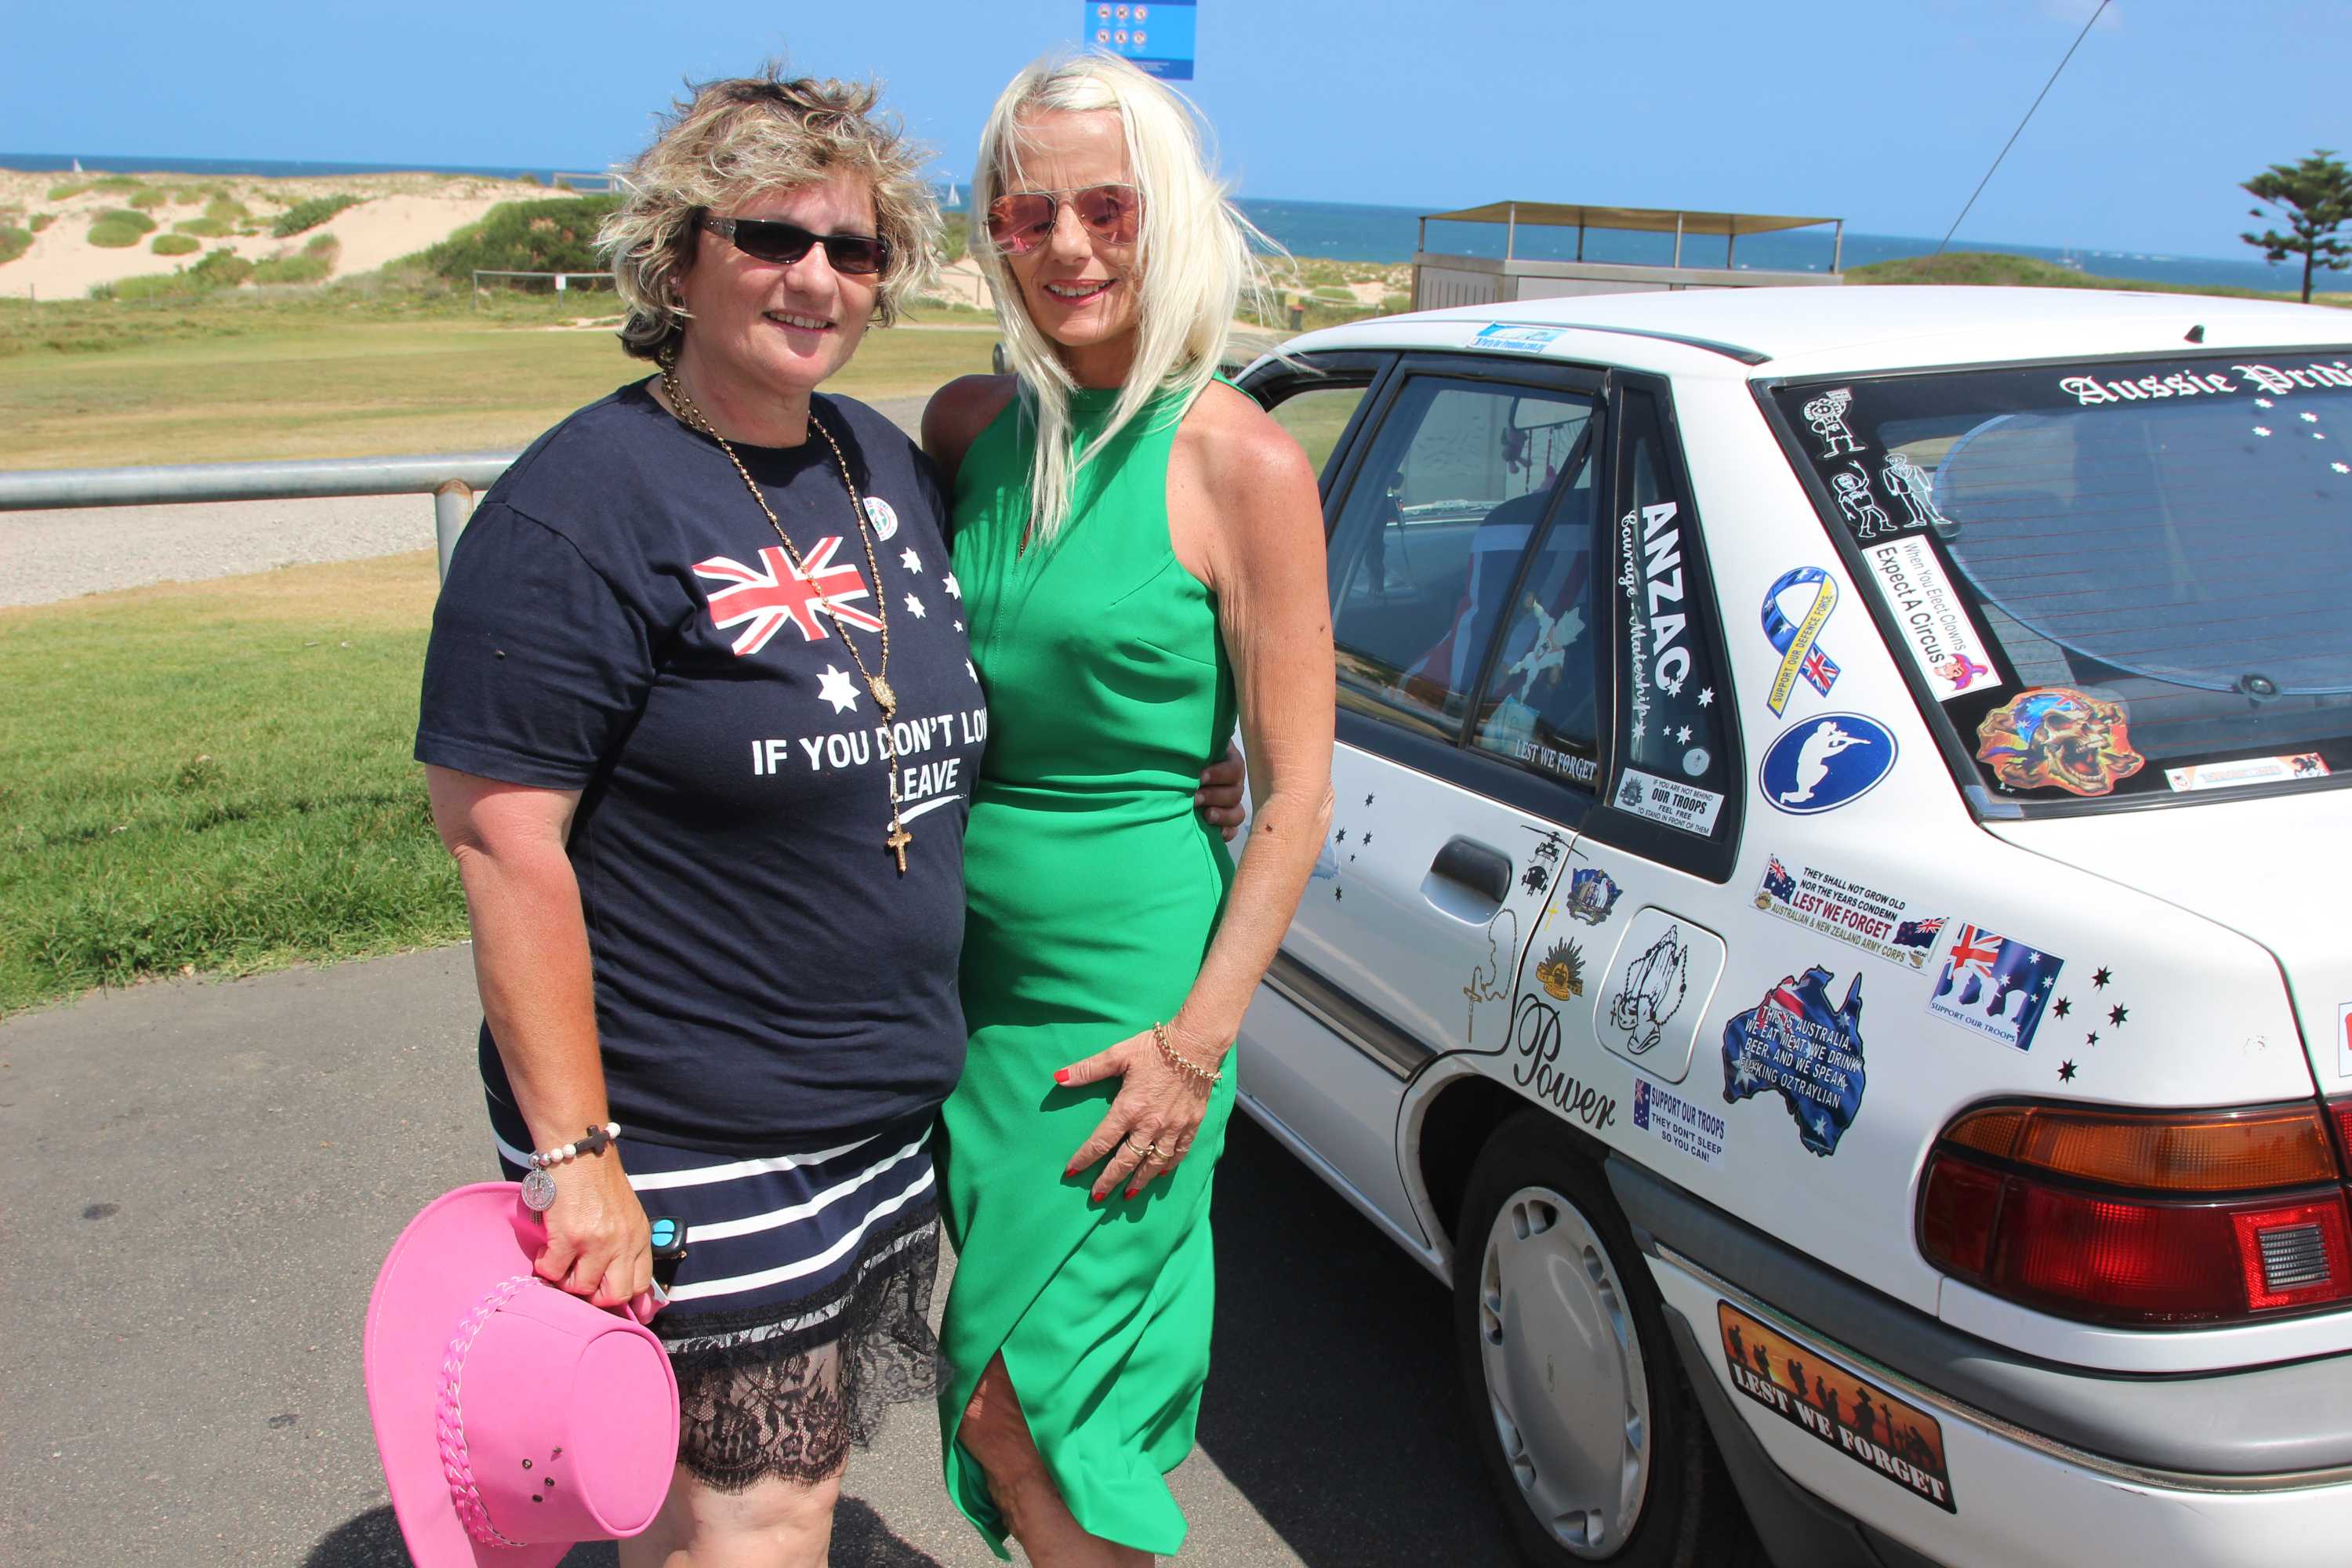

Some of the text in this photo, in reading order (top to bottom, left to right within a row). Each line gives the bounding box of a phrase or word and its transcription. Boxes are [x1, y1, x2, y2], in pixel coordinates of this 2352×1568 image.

[2060, 361, 2352, 405] Aussie Prid
[1618, 510, 1638, 598] Courage
[1629, 616, 1651, 720] Mateship
[1642, 502, 1690, 691] ANZAC
[1876, 546, 1945, 663] Expect A Circus
[1904, 543, 1966, 651] When You Elect Clowns
[1773, 595, 1833, 702] SUPPORT OUR DEFENCE FORCE
[752, 739, 787, 775] IF
[799, 729, 869, 771] YOU
[876, 714, 953, 760] DON'T
[1515, 739, 1597, 782] LEST WE FORGET
[889, 758, 960, 804] LEAVE
[1651, 787, 1708, 815] OUR TROOPS
[1658, 780, 1669, 789] YOU
[1670, 783, 1680, 792] ARE
[1681, 786, 1693, 796] NOT
[1693, 789, 1713, 802] BEHIND
[1637, 806, 1710, 835] TO STAND IN FRONT OF THEM
[1657, 804, 1692, 821] FEEL FREE
[1800, 880, 1898, 922] NOR THE YEARS CONDEMN
[1803, 867, 1906, 911] THEY SHALL NOT GROW OLD
[1770, 903, 1906, 963] AUSTRALIAN & NEW ZEALAND ARMY CORPS
[1792, 891, 1893, 940] LEST WE FORGET
[1745, 1018, 1760, 1036] WE
[1761, 1023, 1780, 1042] EAT
[1809, 1042, 1828, 1062] WE
[1828, 1049, 1857, 1073] DRINK
[1761, 1006, 1852, 1052] THIS IS AUSTRALIA.
[1931, 1003, 2016, 1043] SUPPORT OUR TROOPS
[1513, 993, 1615, 1131] Power
[1773, 1047, 1794, 1067] AND
[1795, 1057, 1811, 1075] WE
[1813, 1063, 1846, 1088] SPEAK
[1651, 1087, 1725, 1140] SUPPORT OUR TROOPS
[1780, 1073, 1841, 1109] OZTRAYLIAN
[1652, 1112, 1722, 1155] THEY DON'T SLEEP
[1661, 1131, 1709, 1162] SO YOU CAN!
[1731, 1362, 1945, 1502] LEST WE FORGET
